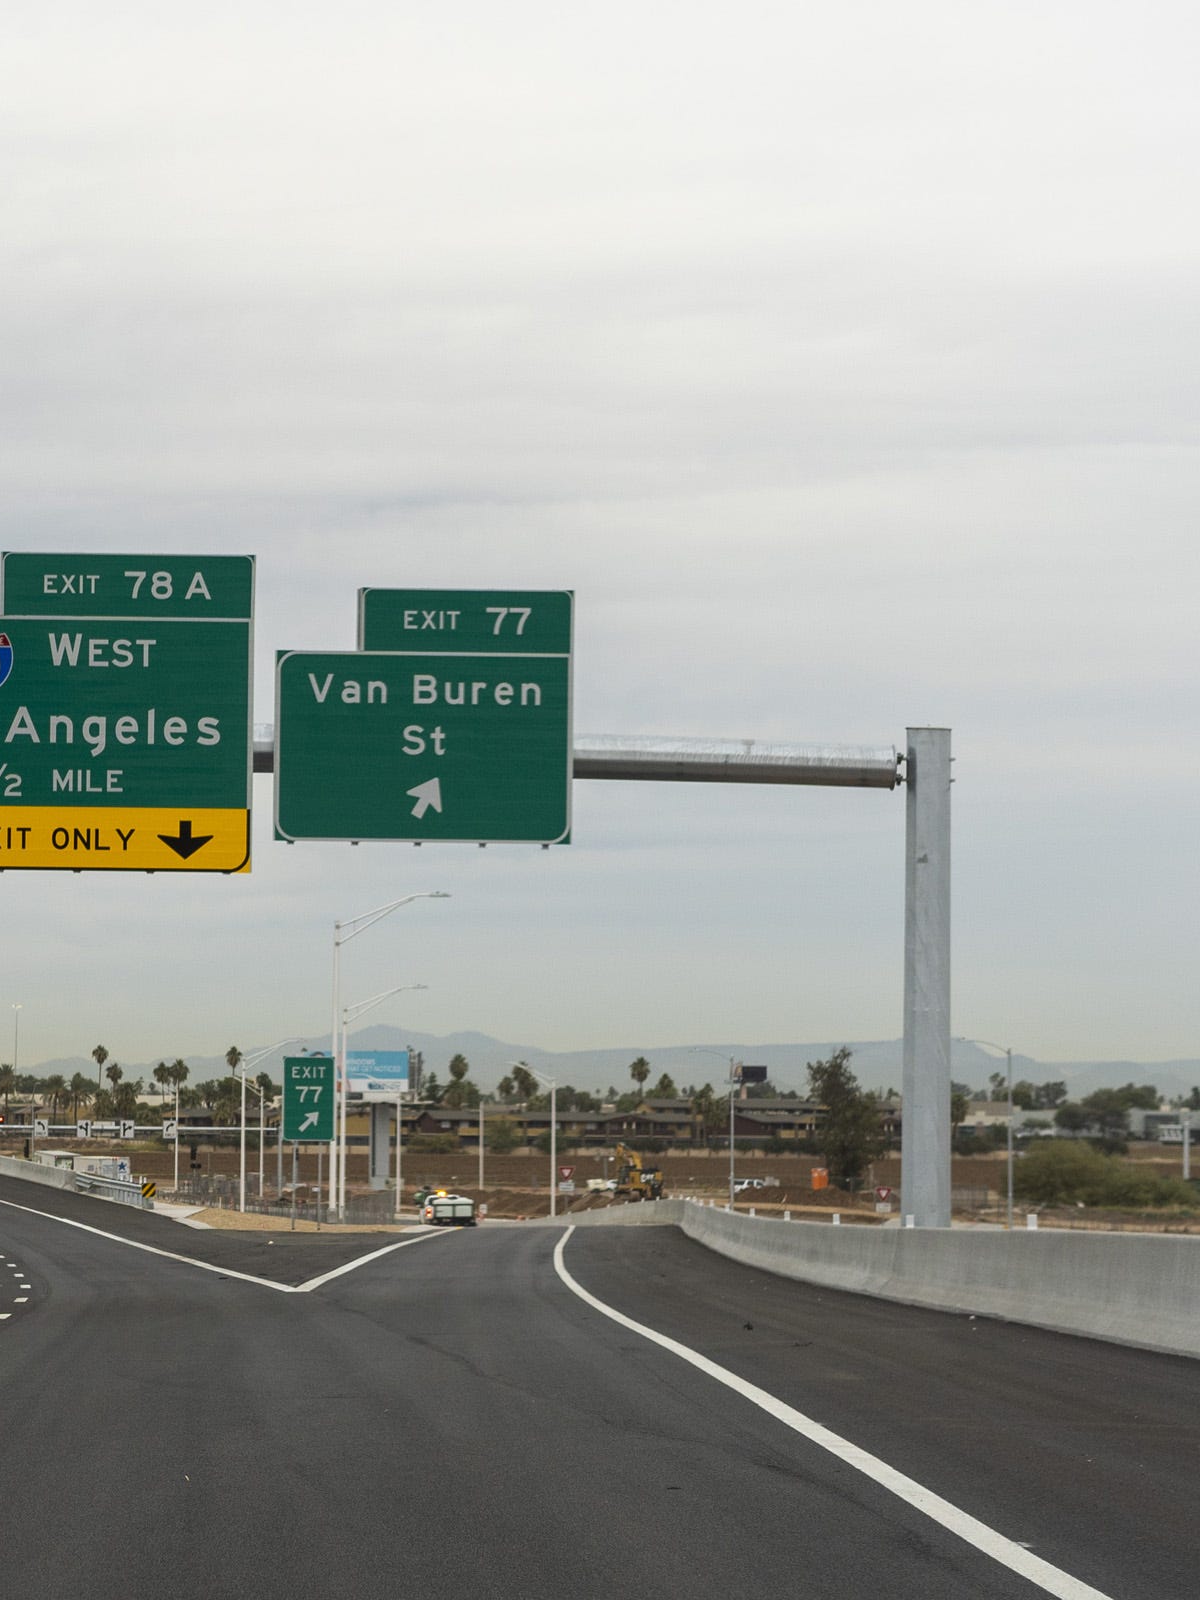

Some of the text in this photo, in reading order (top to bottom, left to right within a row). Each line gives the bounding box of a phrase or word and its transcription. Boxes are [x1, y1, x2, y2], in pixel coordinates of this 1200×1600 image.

[44, 575, 99, 593] EXIT
[404, 607, 531, 635] EXIT 77
[49, 633, 156, 667] WEST
[309, 673, 541, 705] Van Buren
[5, 706, 220, 757] Angeles
[402, 725, 445, 755] St
[53, 769, 123, 792] MILE
[52, 828, 135, 850] ONLY
[292, 1067, 326, 1078] EXIT
[296, 1086, 322, 1103] 77
